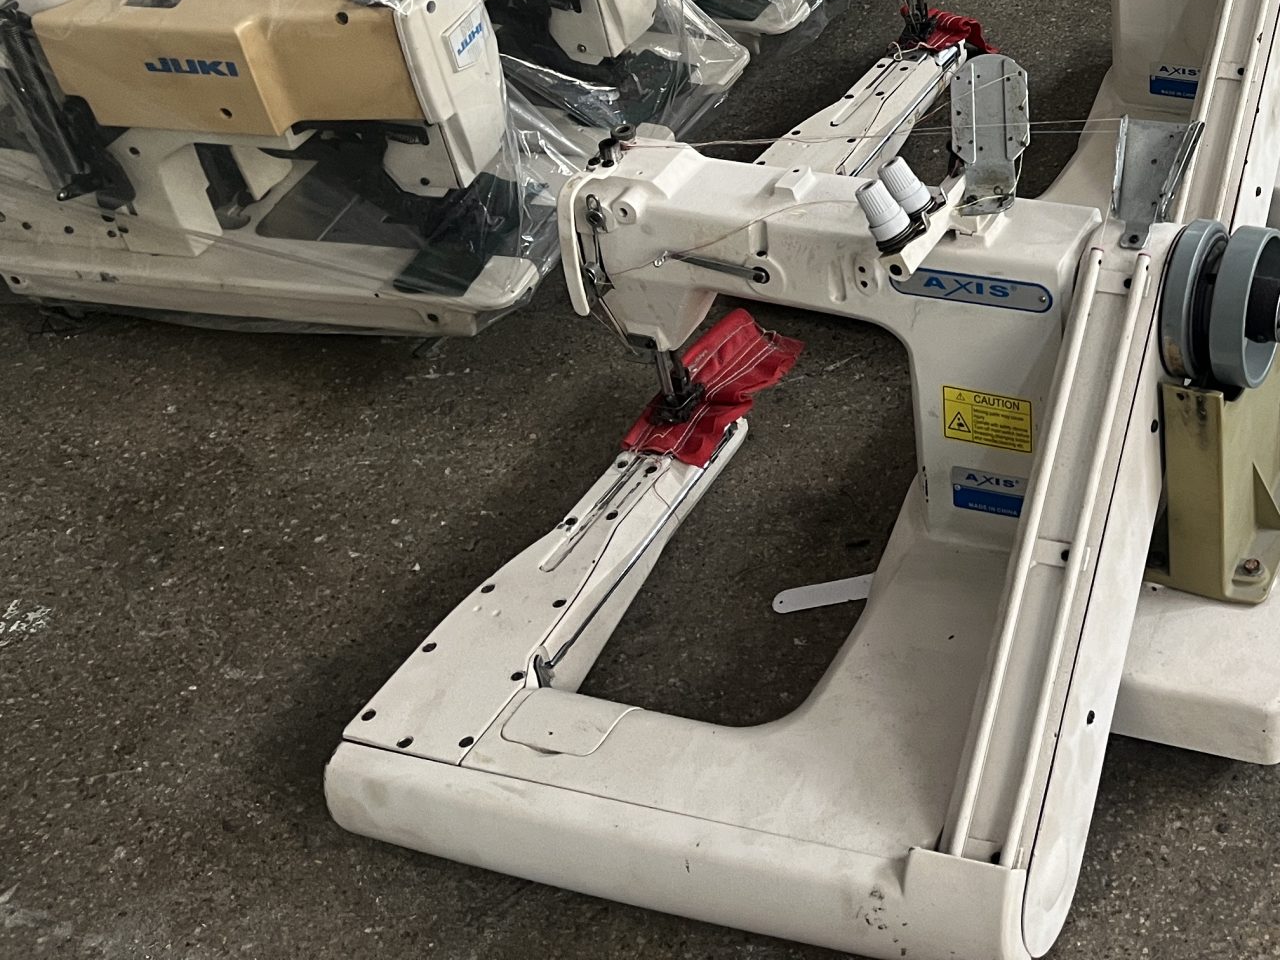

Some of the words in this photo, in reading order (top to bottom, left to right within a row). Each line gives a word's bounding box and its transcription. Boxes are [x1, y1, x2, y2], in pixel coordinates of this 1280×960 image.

[457, 22, 483, 55] JUKI
[144, 57, 239, 77] JUKI
[1159, 65, 1197, 76] AXIS
[923, 276, 1010, 298] AXIS
[973, 394, 1020, 411] CAUTION
[965, 473, 1015, 488] AXIS
[968, 502, 987, 511] MADE
[997, 507, 1018, 516] CHINA
